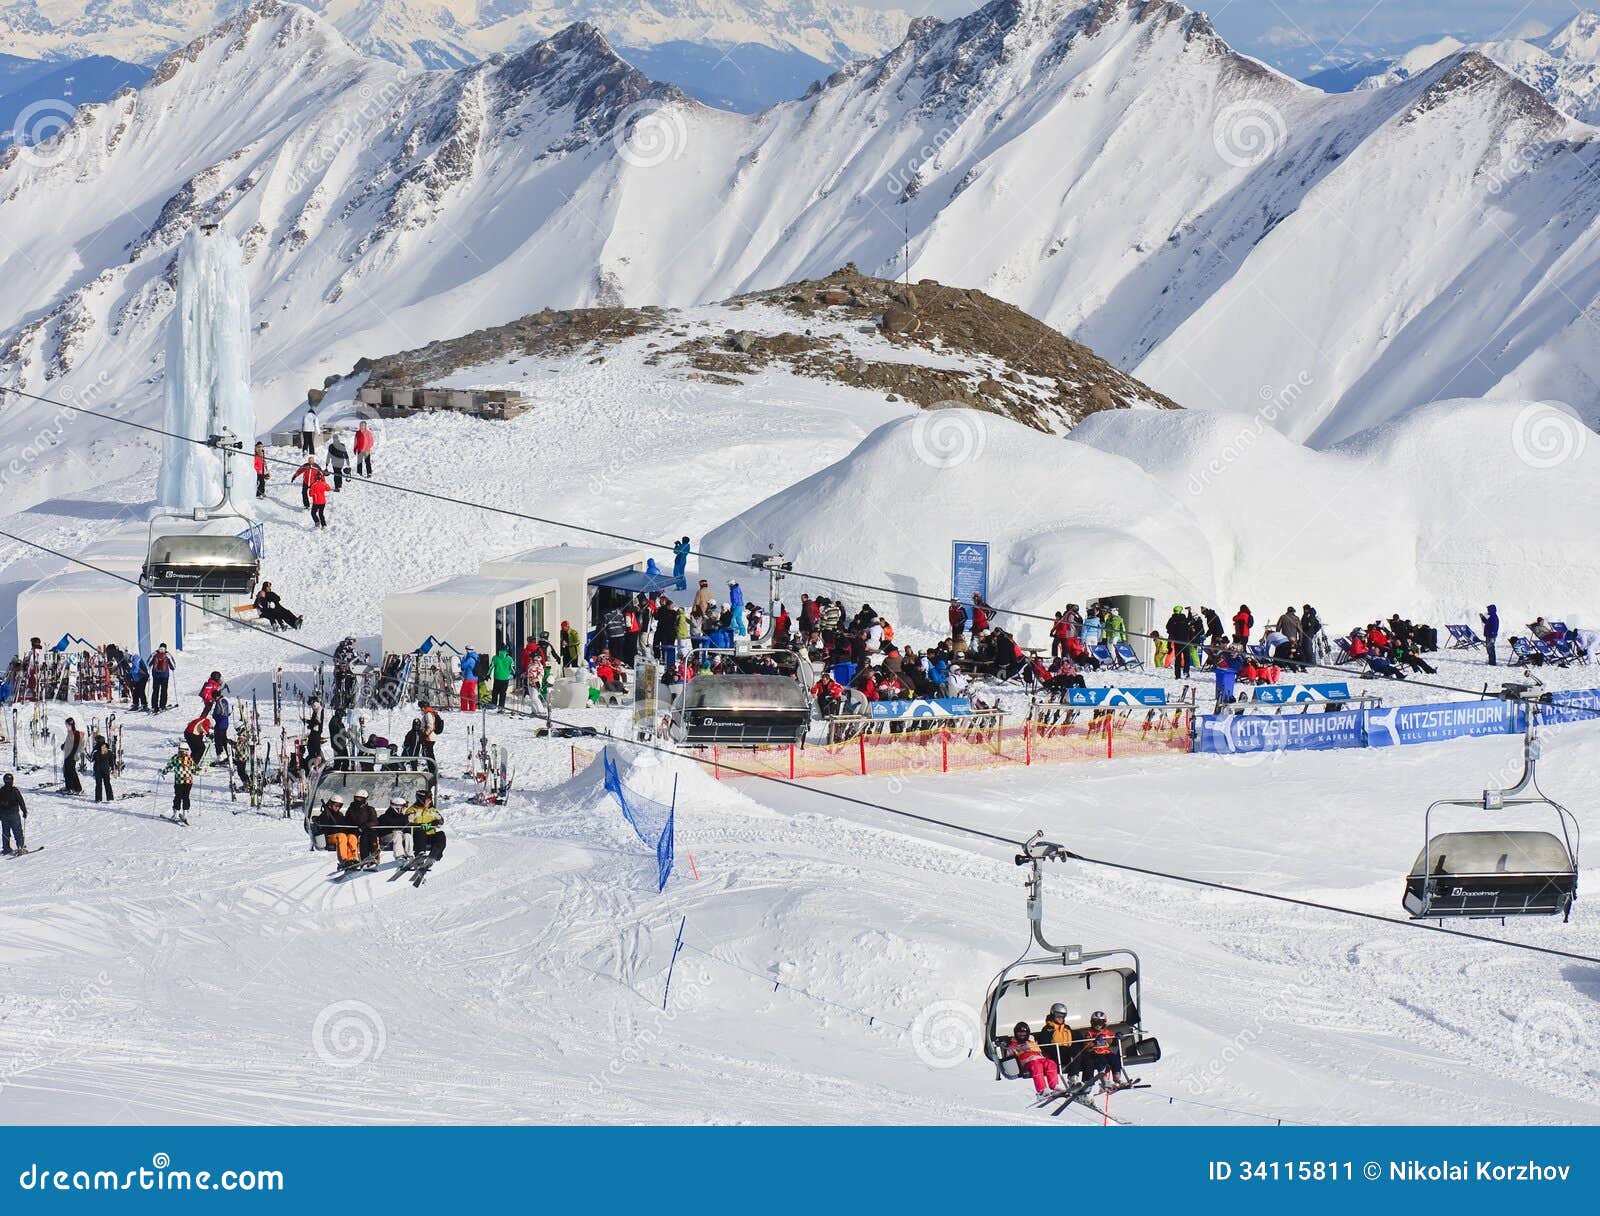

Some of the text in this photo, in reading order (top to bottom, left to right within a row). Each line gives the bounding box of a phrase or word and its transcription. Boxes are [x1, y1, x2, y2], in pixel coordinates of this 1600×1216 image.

[1237, 714, 1357, 737] KITZSTEINHORN
[1401, 706, 1503, 731] KITZSTEINHORN
[1318, 733, 1356, 742] KAPRUN
[1401, 732, 1422, 740] ZELL
[1469, 726, 1505, 734] KAPRUN
